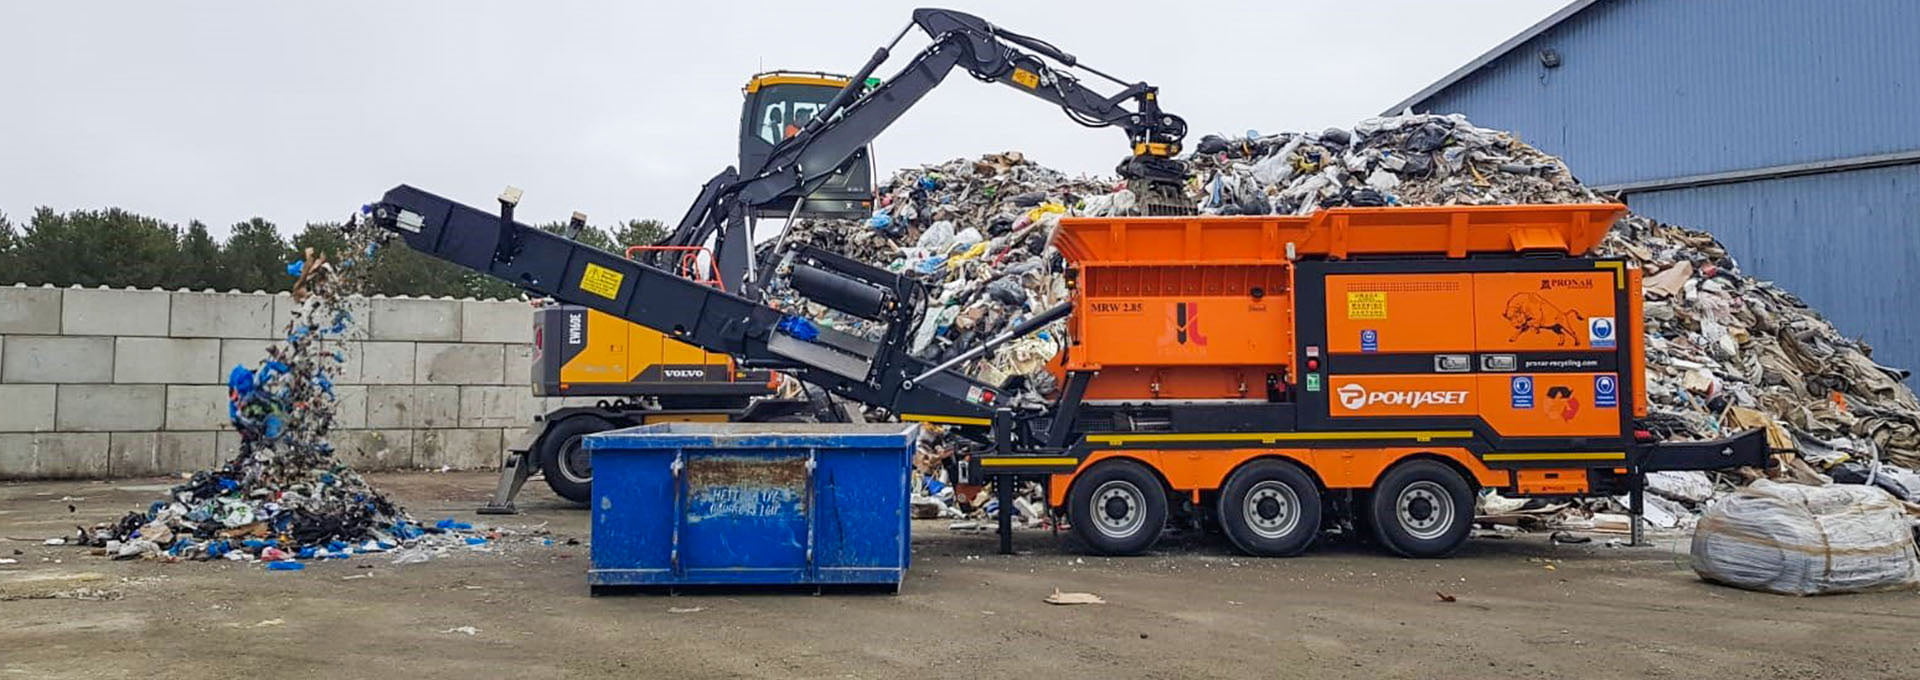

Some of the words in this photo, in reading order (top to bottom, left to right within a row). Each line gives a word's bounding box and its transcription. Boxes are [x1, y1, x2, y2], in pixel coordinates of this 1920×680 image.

[1551, 279, 1593, 287] PRONAR
[1091, 303, 1119, 313] MRW
[1123, 303, 1142, 313] 2.85
[569, 313, 582, 344] EW160E
[664, 369, 704, 377] VOLVO
[1367, 390, 1470, 409] POHJASET
